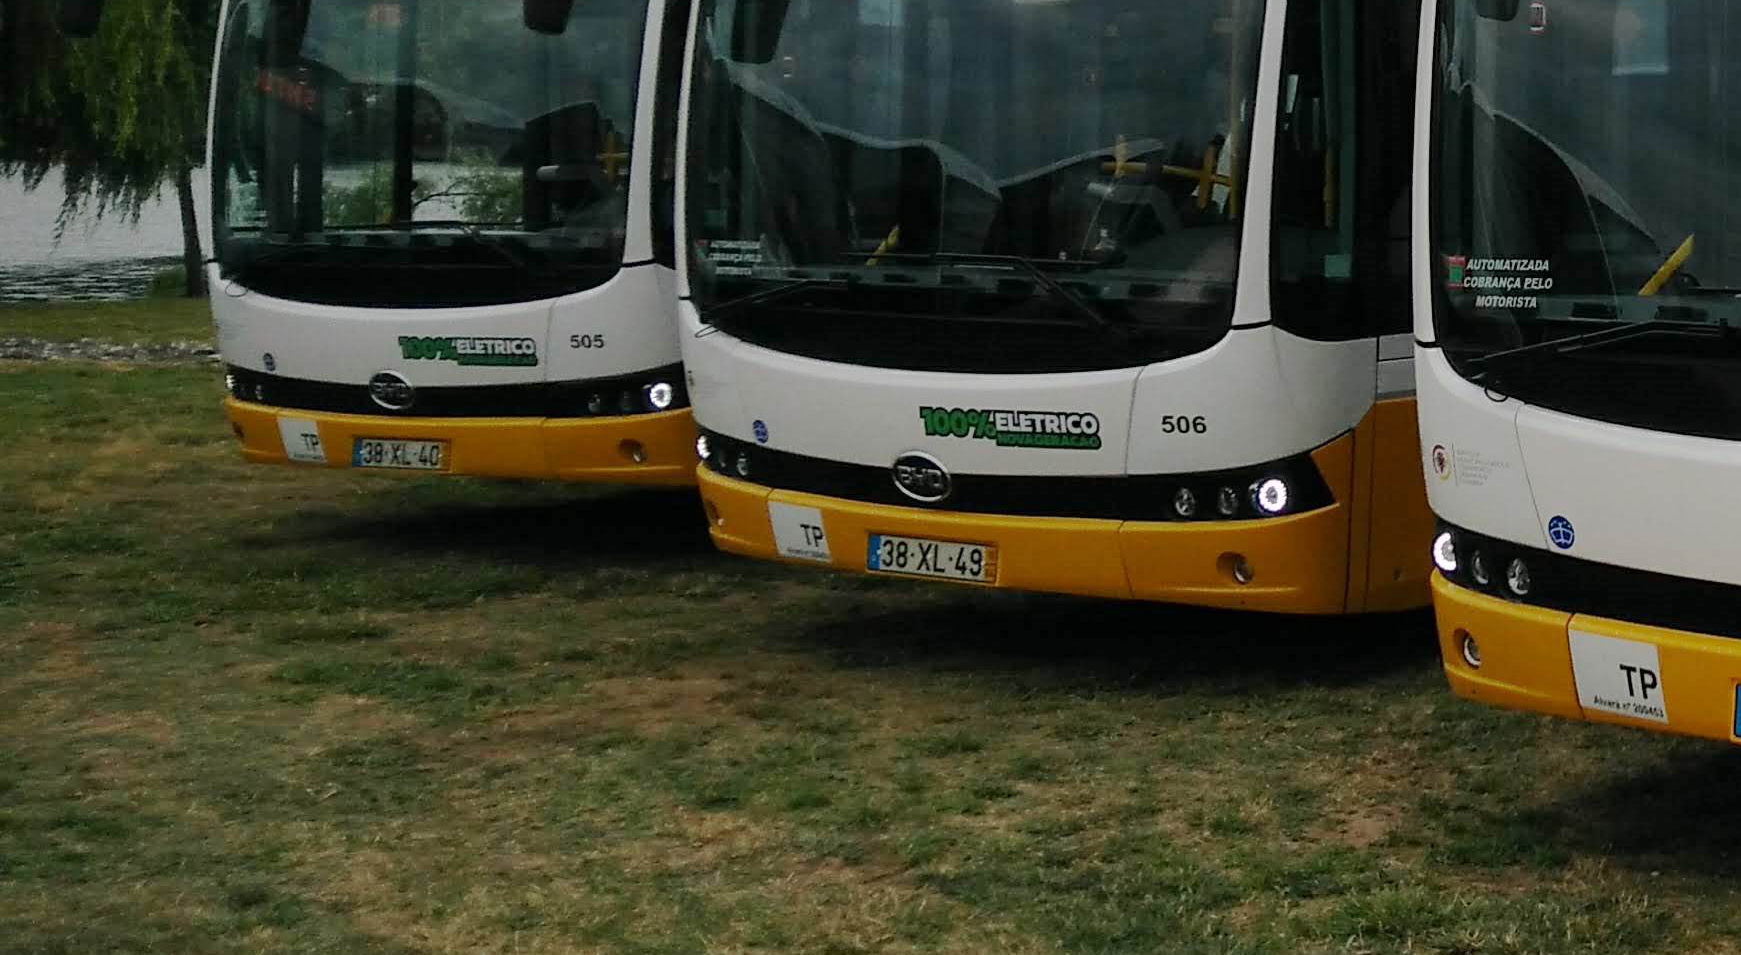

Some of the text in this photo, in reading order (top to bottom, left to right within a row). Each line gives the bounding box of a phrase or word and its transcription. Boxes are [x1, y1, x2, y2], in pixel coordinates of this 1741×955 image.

[1466, 259, 1549, 271] AUTOMATIZADA
[1463, 276, 1553, 291] COBRANÇA PELO
[1476, 295, 1537, 308] MOTORISTA
[570, 334, 604, 349] 505
[921, 407, 996, 439] 100%
[1161, 415, 1207, 434] 506
[301, 433, 319, 451] TP
[800, 524, 824, 547] TP
[1619, 664, 1658, 699] TP
